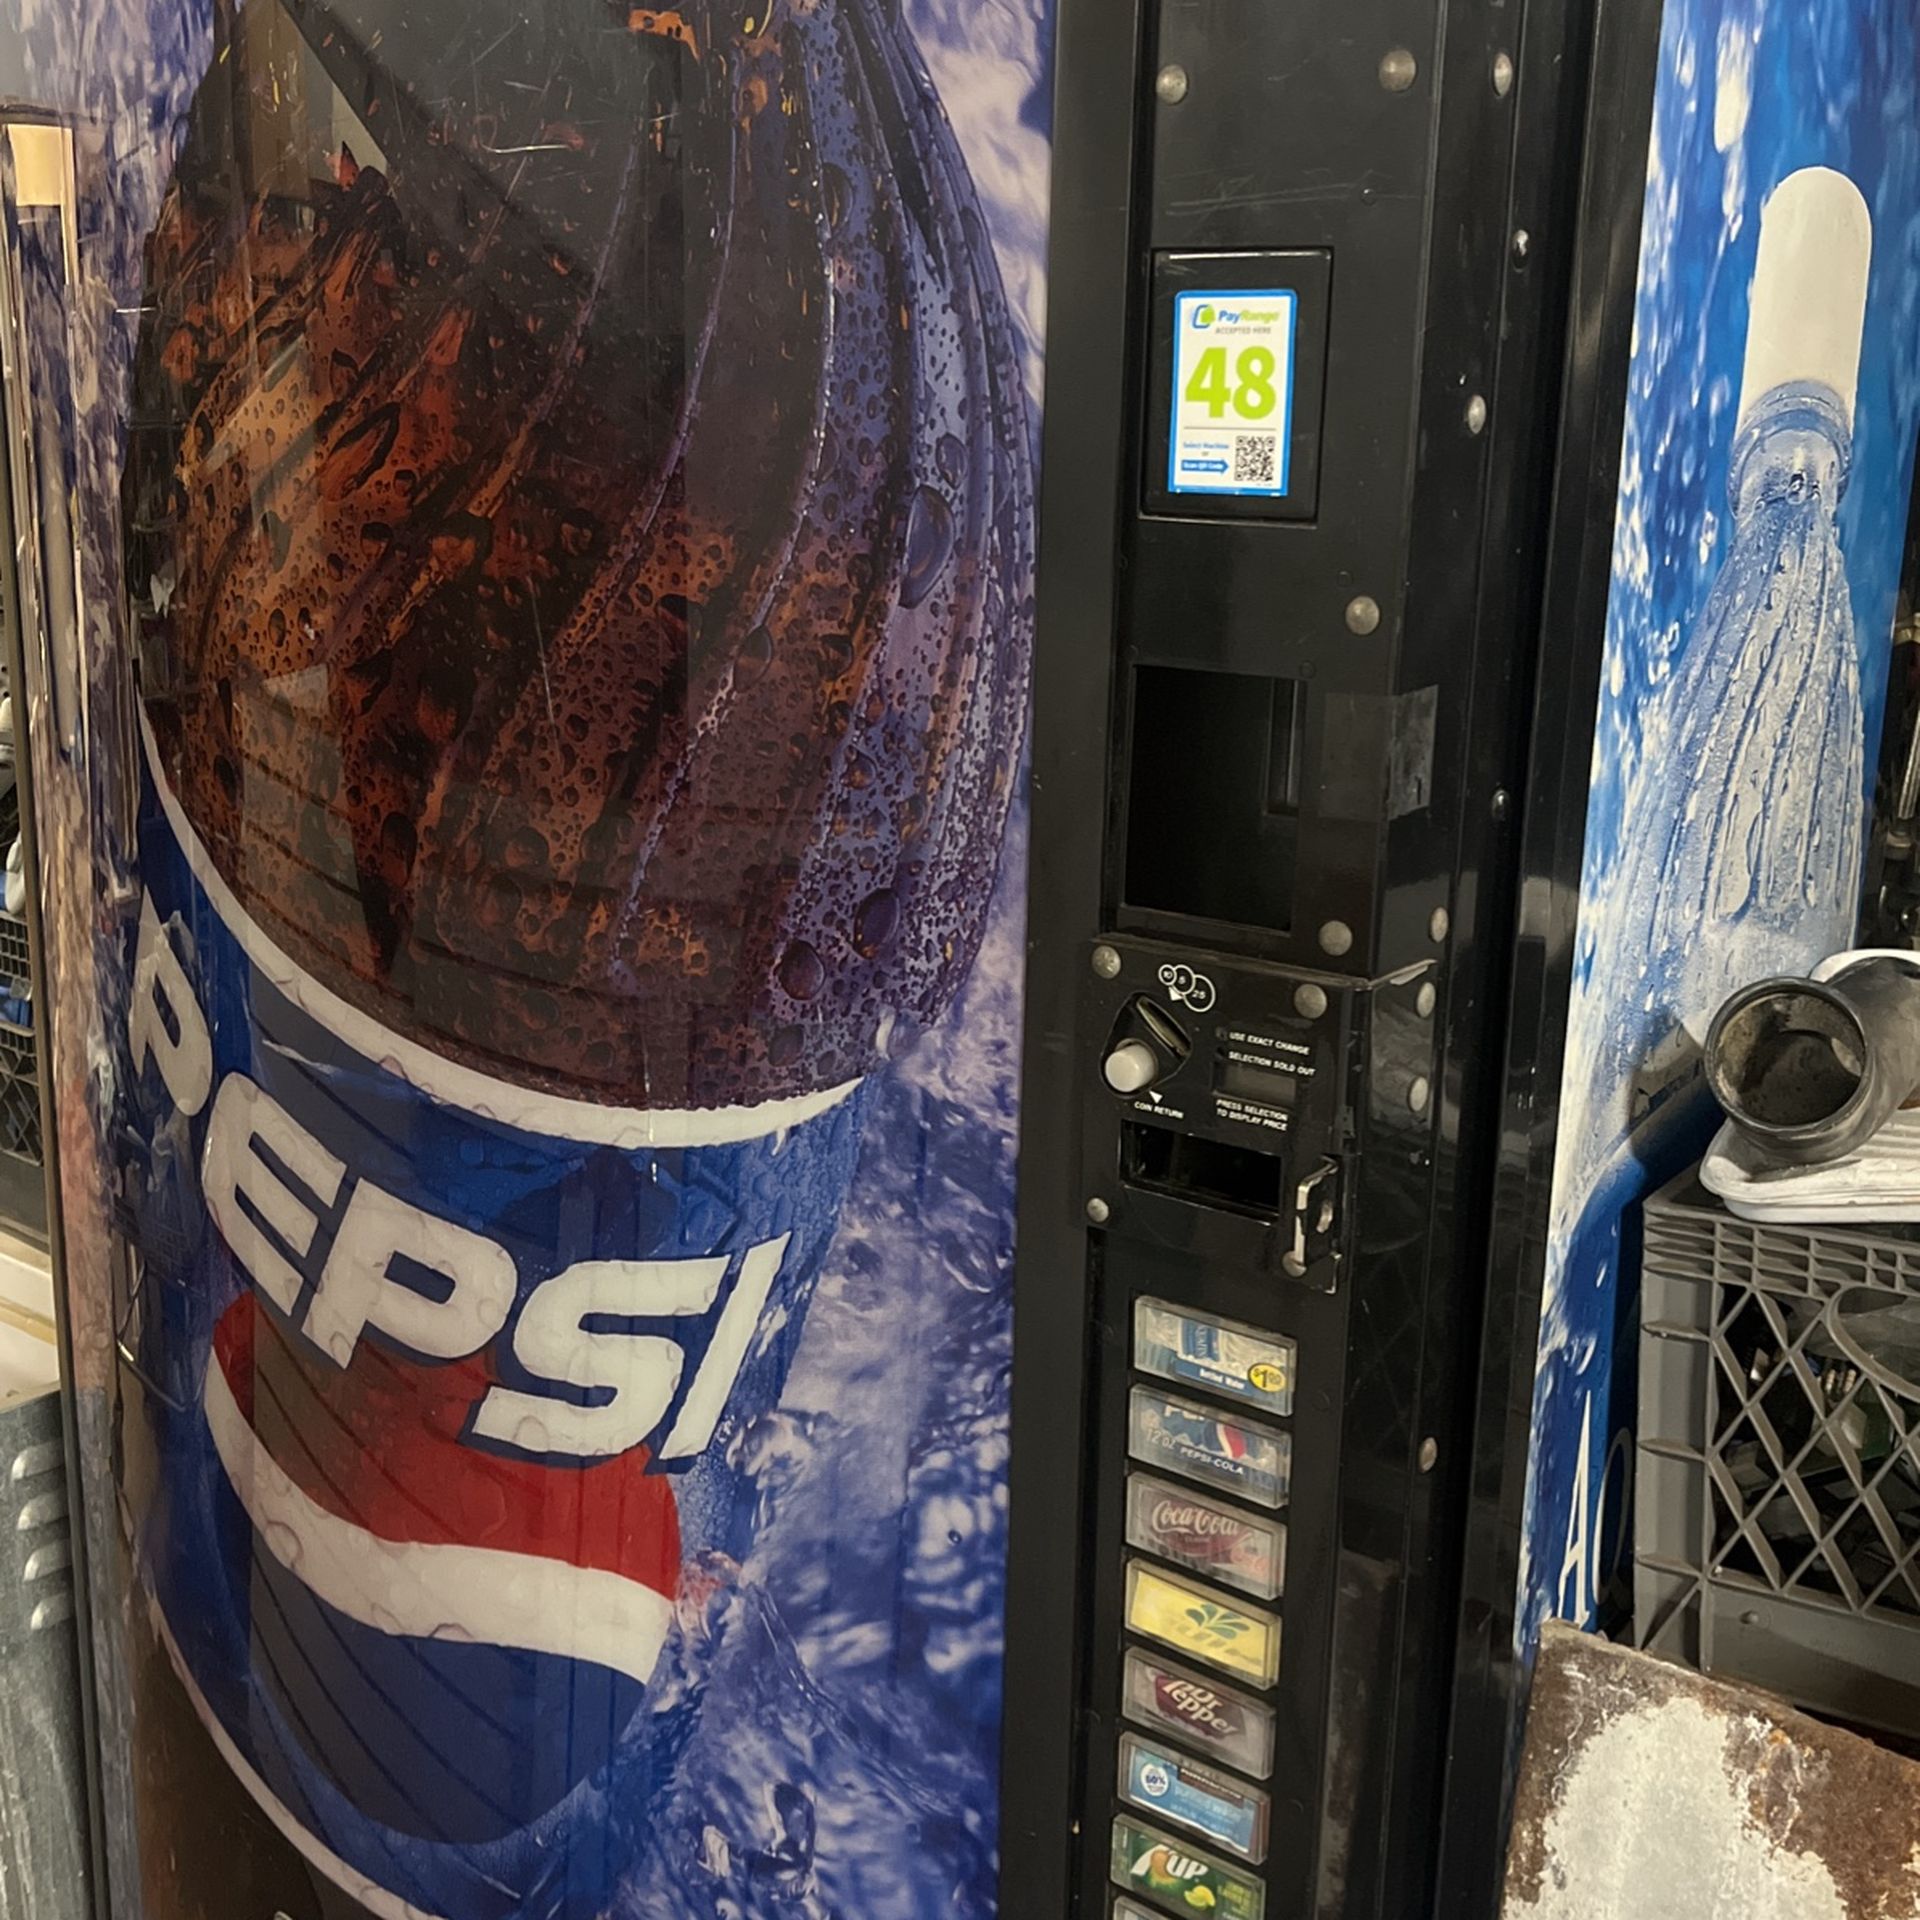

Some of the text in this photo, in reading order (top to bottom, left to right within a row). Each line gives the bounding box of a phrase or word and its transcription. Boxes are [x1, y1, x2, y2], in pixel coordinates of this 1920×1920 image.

[1218, 310, 1279, 324] PayRange
[1215, 326, 1251, 335] ACCEPTED
[1185, 346, 1276, 420] 48
[1163, 970, 1174, 980] 10
[1192, 989, 1207, 1000] 25
[1229, 1031, 1310, 1056] USE EXACT CHANGE
[1228, 1050, 1317, 1077] SELECTION SOLD OUT
[1134, 1100, 1185, 1120] COIN RETURN
[1215, 1098, 1289, 1122] PRESS SELECTION
[1216, 1107, 1289, 1132] TO DISPLAY PRICE
[129, 884, 792, 1461] PEPSI
[1180, 1444, 1245, 1476] PEPSI-COLA
[1152, 1499, 1239, 1536] Coca-Cola
[1161, 1680, 1239, 1734] Pepper
